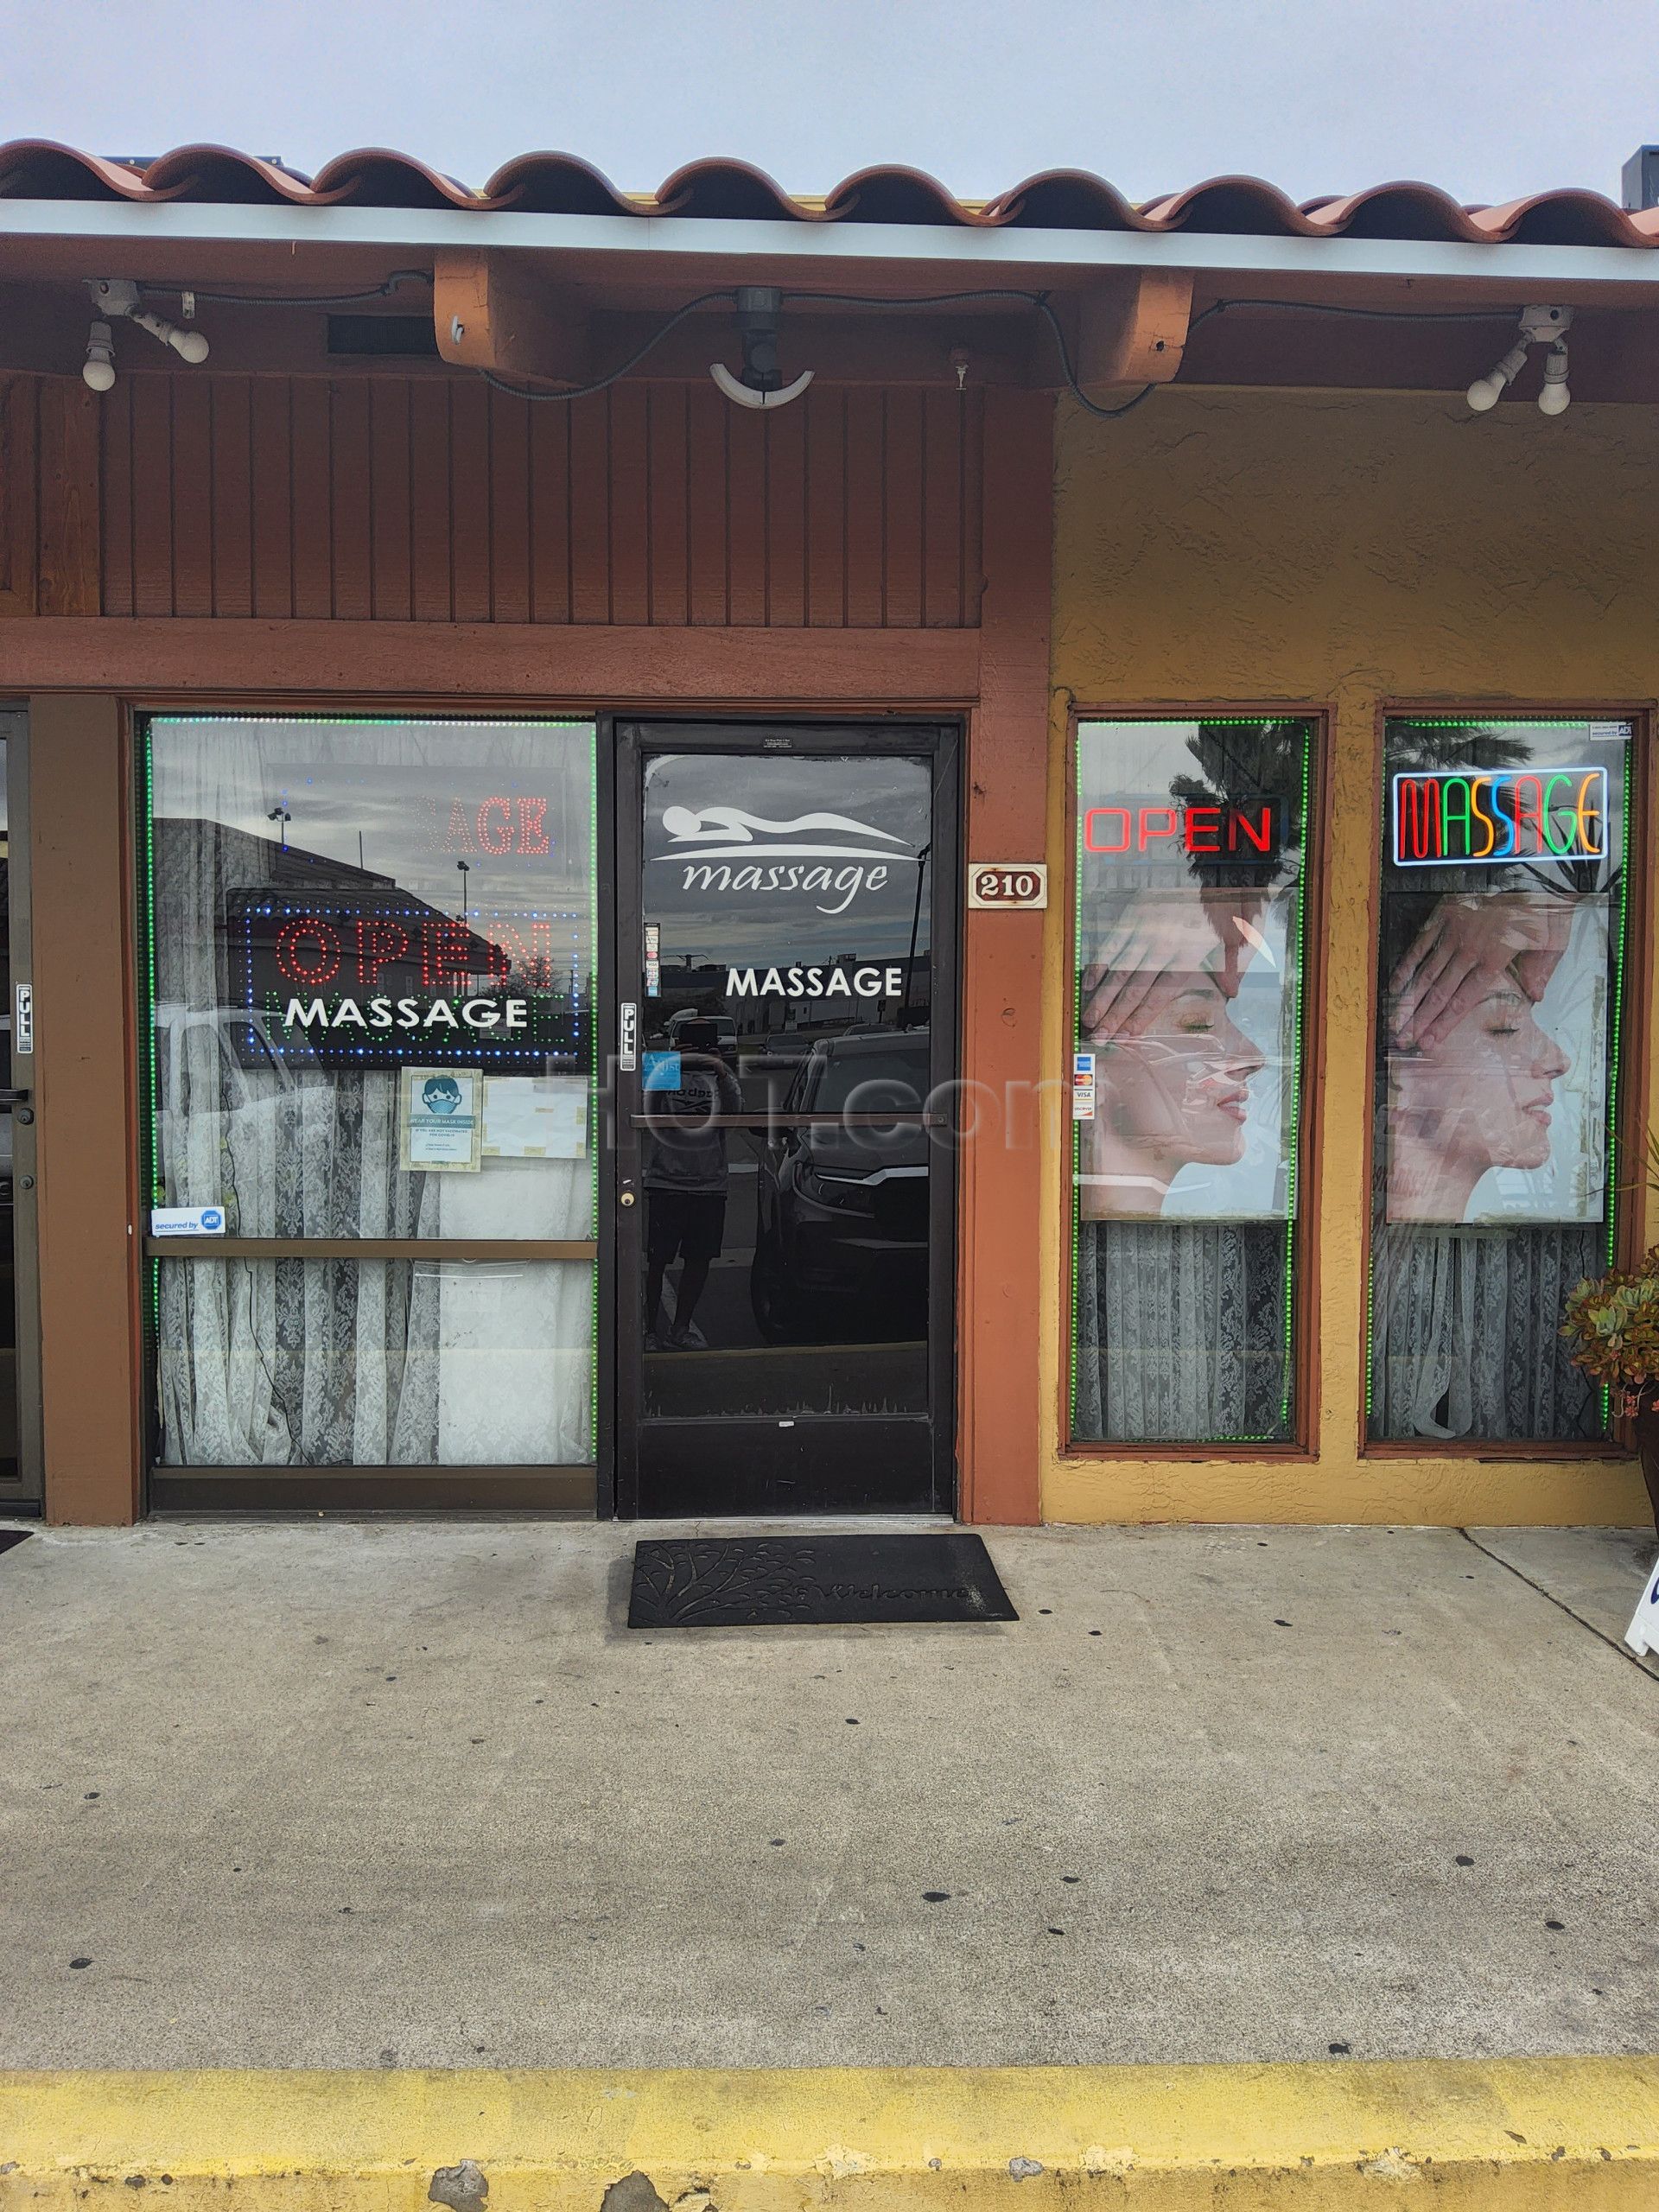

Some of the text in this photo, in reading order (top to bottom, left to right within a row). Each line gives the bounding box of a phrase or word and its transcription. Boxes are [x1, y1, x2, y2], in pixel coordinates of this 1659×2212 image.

[1084, 807, 1271, 852] OPEN
[1399, 773, 1600, 859] MASSAGE
[683, 865, 888, 914] massage
[981, 874, 1033, 896] 210
[276, 919, 550, 987] OPEN
[726, 967, 902, 996] MASSAGE
[19, 990, 30, 1037] PULL
[285, 998, 527, 1028] MASSAGE
[624, 1008, 634, 1054] PULL
